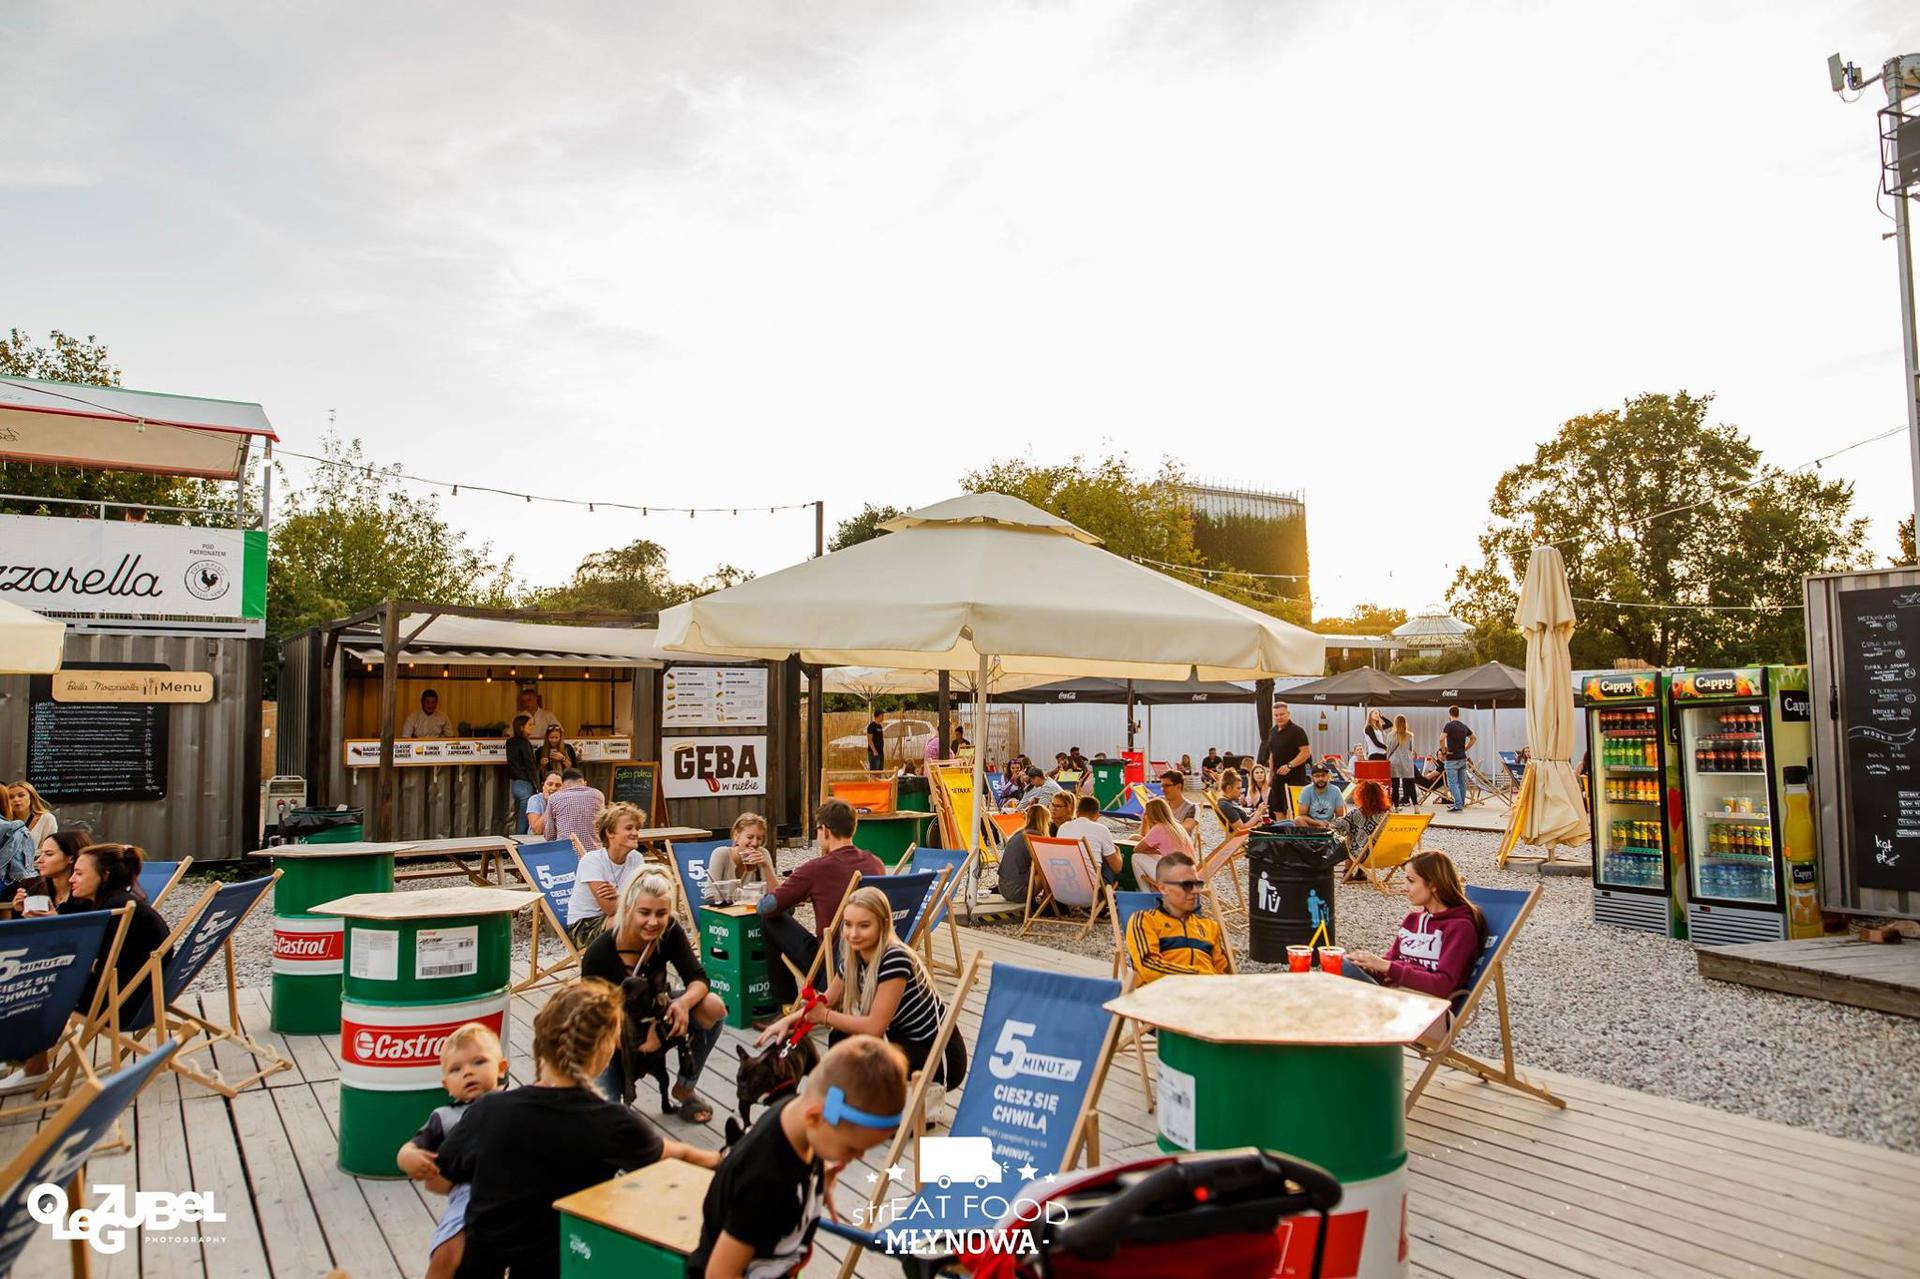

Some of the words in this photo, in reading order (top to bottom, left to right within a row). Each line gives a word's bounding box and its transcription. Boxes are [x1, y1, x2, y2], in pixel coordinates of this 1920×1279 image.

[160, 681, 202, 692] Menu
[1600, 680, 1633, 693] Cappy
[1695, 676, 1735, 690] Cappy
[1784, 696, 1810, 717] Capp
[732, 780, 758, 790] niebie
[536, 865, 554, 889] 5
[277, 936, 326, 956] Castrol
[374, 1033, 450, 1060] Castro
[988, 1019, 1037, 1080] 5
[993, 1084, 1033, 1107] CIESZ
